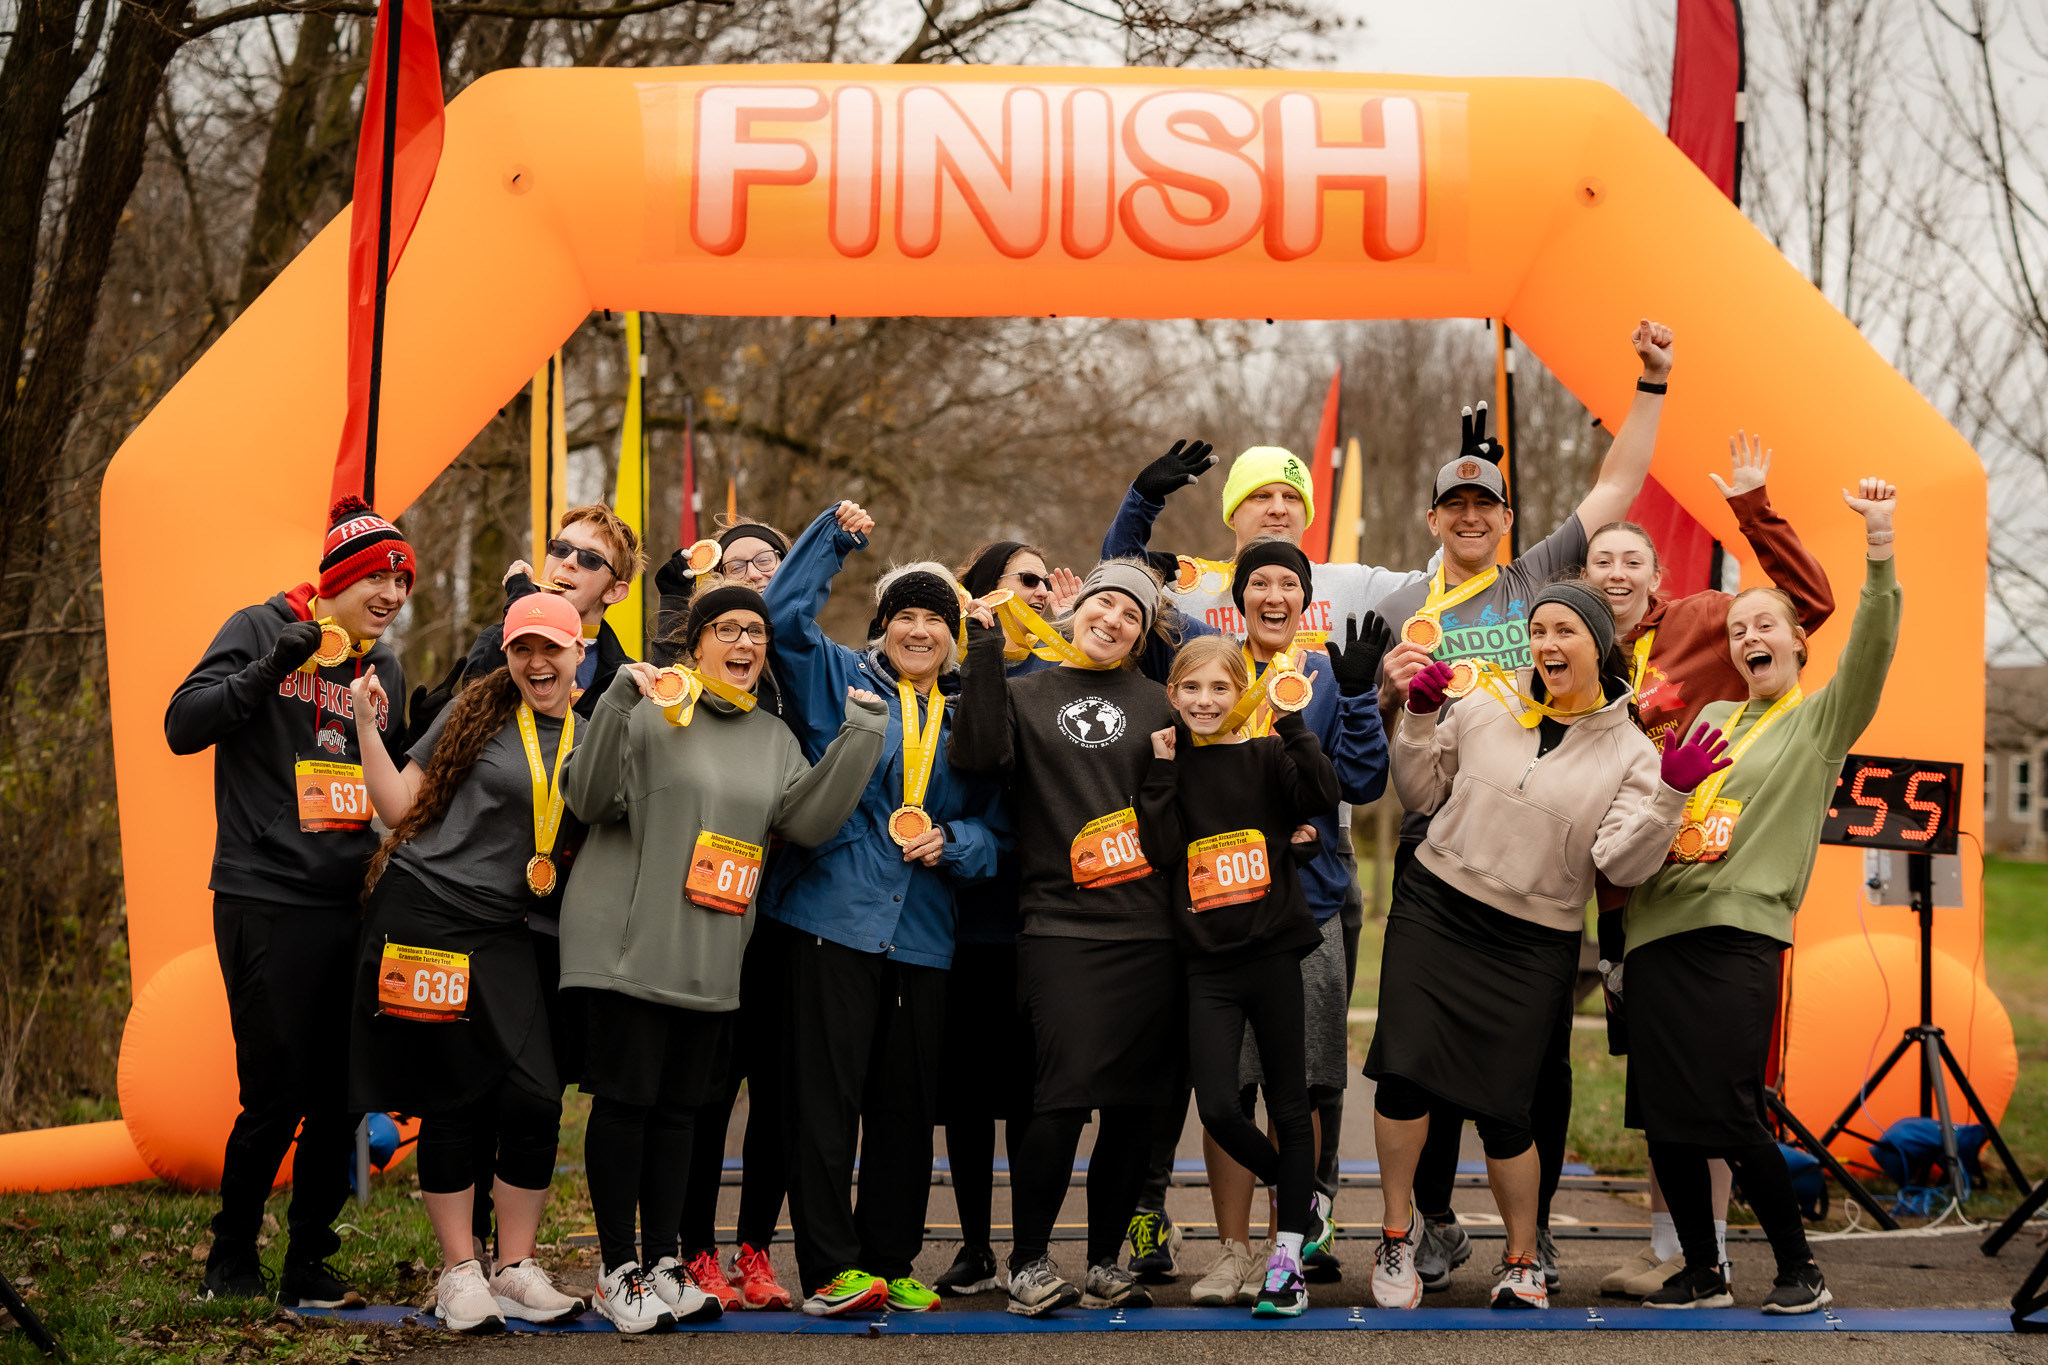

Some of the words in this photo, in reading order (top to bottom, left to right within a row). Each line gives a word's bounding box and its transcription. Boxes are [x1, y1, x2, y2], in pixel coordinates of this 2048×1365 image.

[689, 85, 1426, 262] FINISH
[1205, 606, 1245, 633] OHI
[1298, 600, 1333, 631] ATE
[1646, 719, 1679, 738] ATHON
[524, 728, 533, 741] 1/2
[530, 743, 541, 782] Marathon
[915, 757, 928, 797] Alexandria
[925, 722, 936, 749] Granville
[931, 702, 940, 721] Turkey
[330, 782, 367, 814] 637
[1705, 816, 1732, 846] 26
[718, 860, 759, 898] 610
[1216, 848, 1266, 886] 608
[413, 969, 465, 1005] 636
